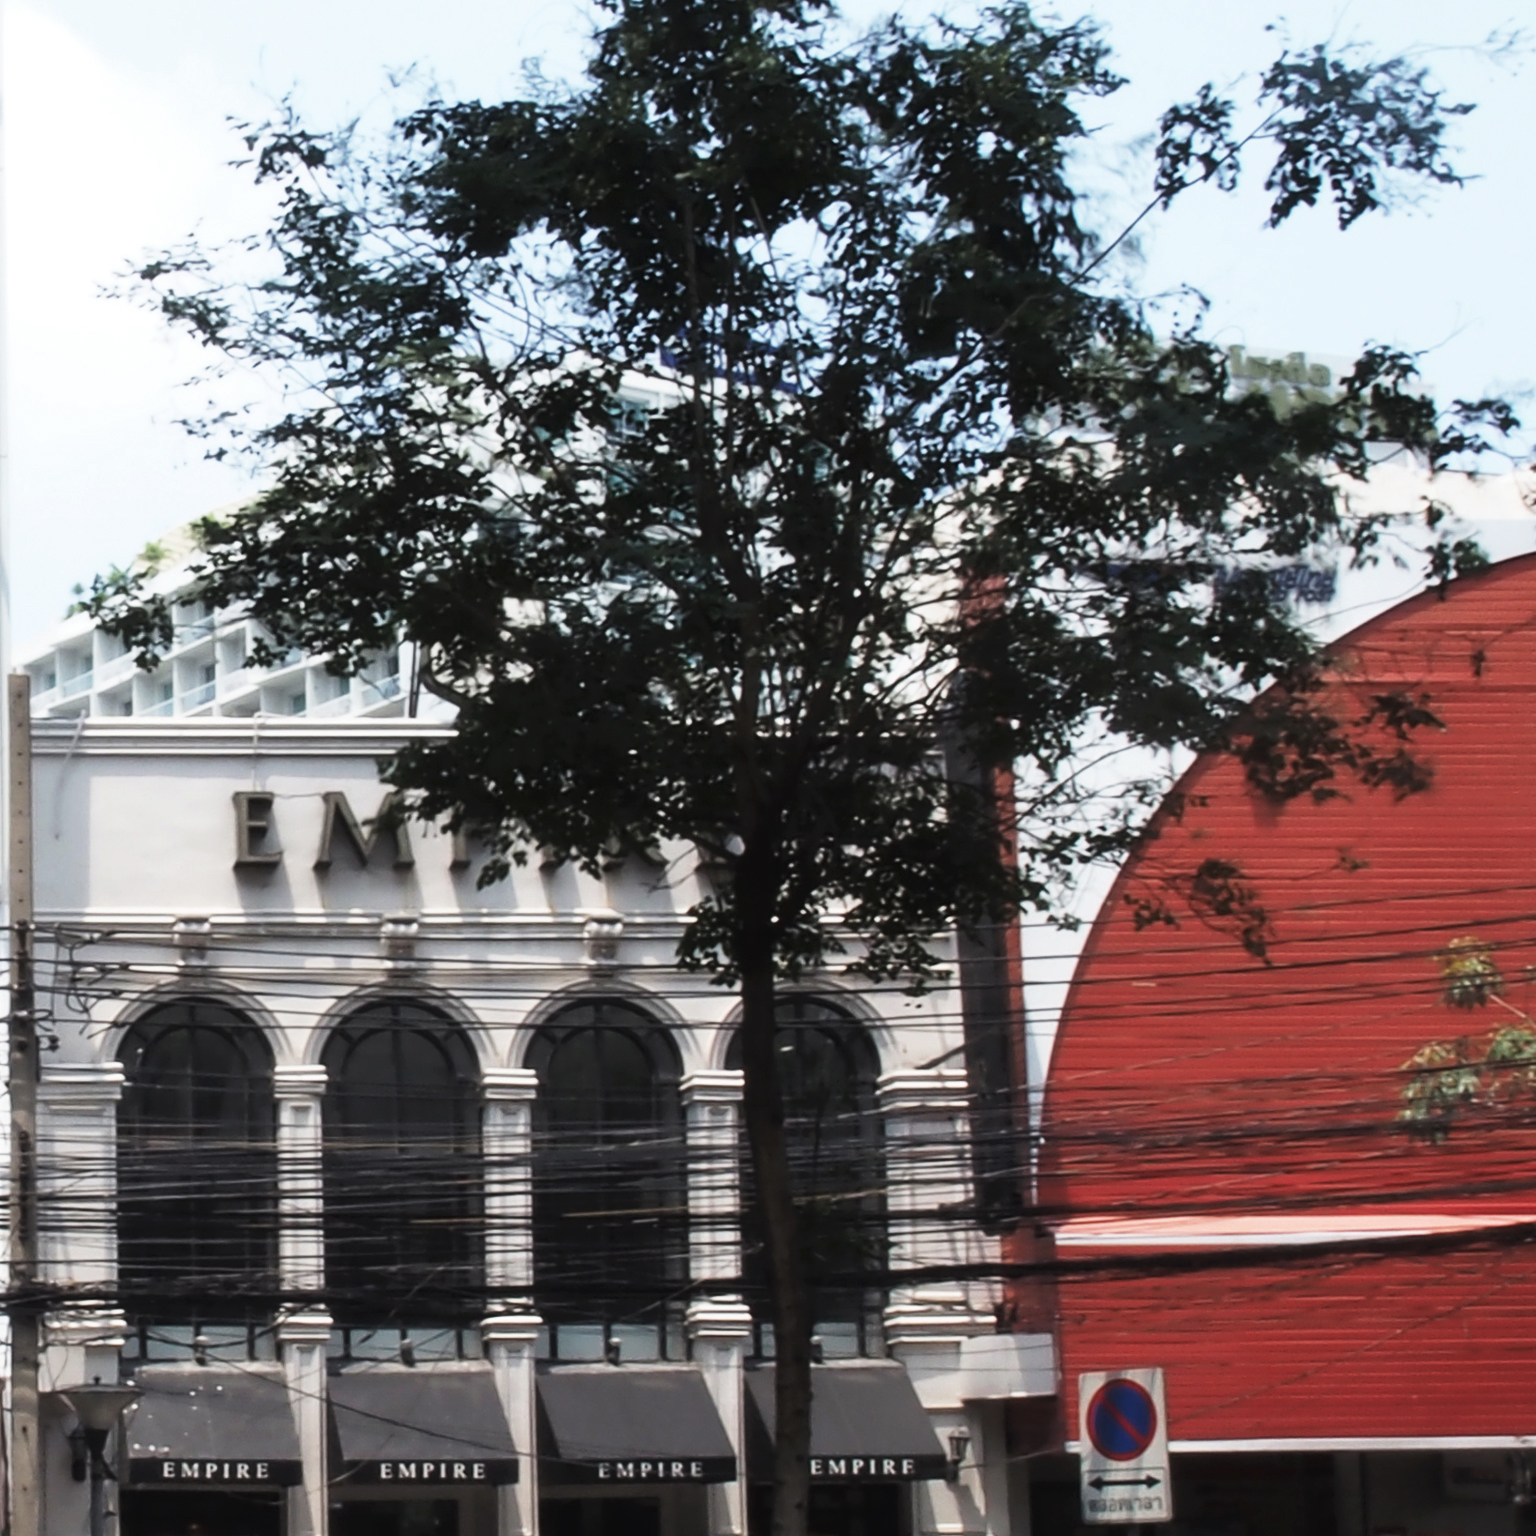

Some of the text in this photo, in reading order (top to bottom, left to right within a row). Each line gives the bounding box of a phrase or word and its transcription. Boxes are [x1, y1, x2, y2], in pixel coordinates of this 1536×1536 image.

[162, 1461, 270, 1479] EMPIRE
[380, 1462, 486, 1479] EMPIRE
[598, 1462, 704, 1479] EMPIRE
[809, 1457, 916, 1476] EMPIRE
